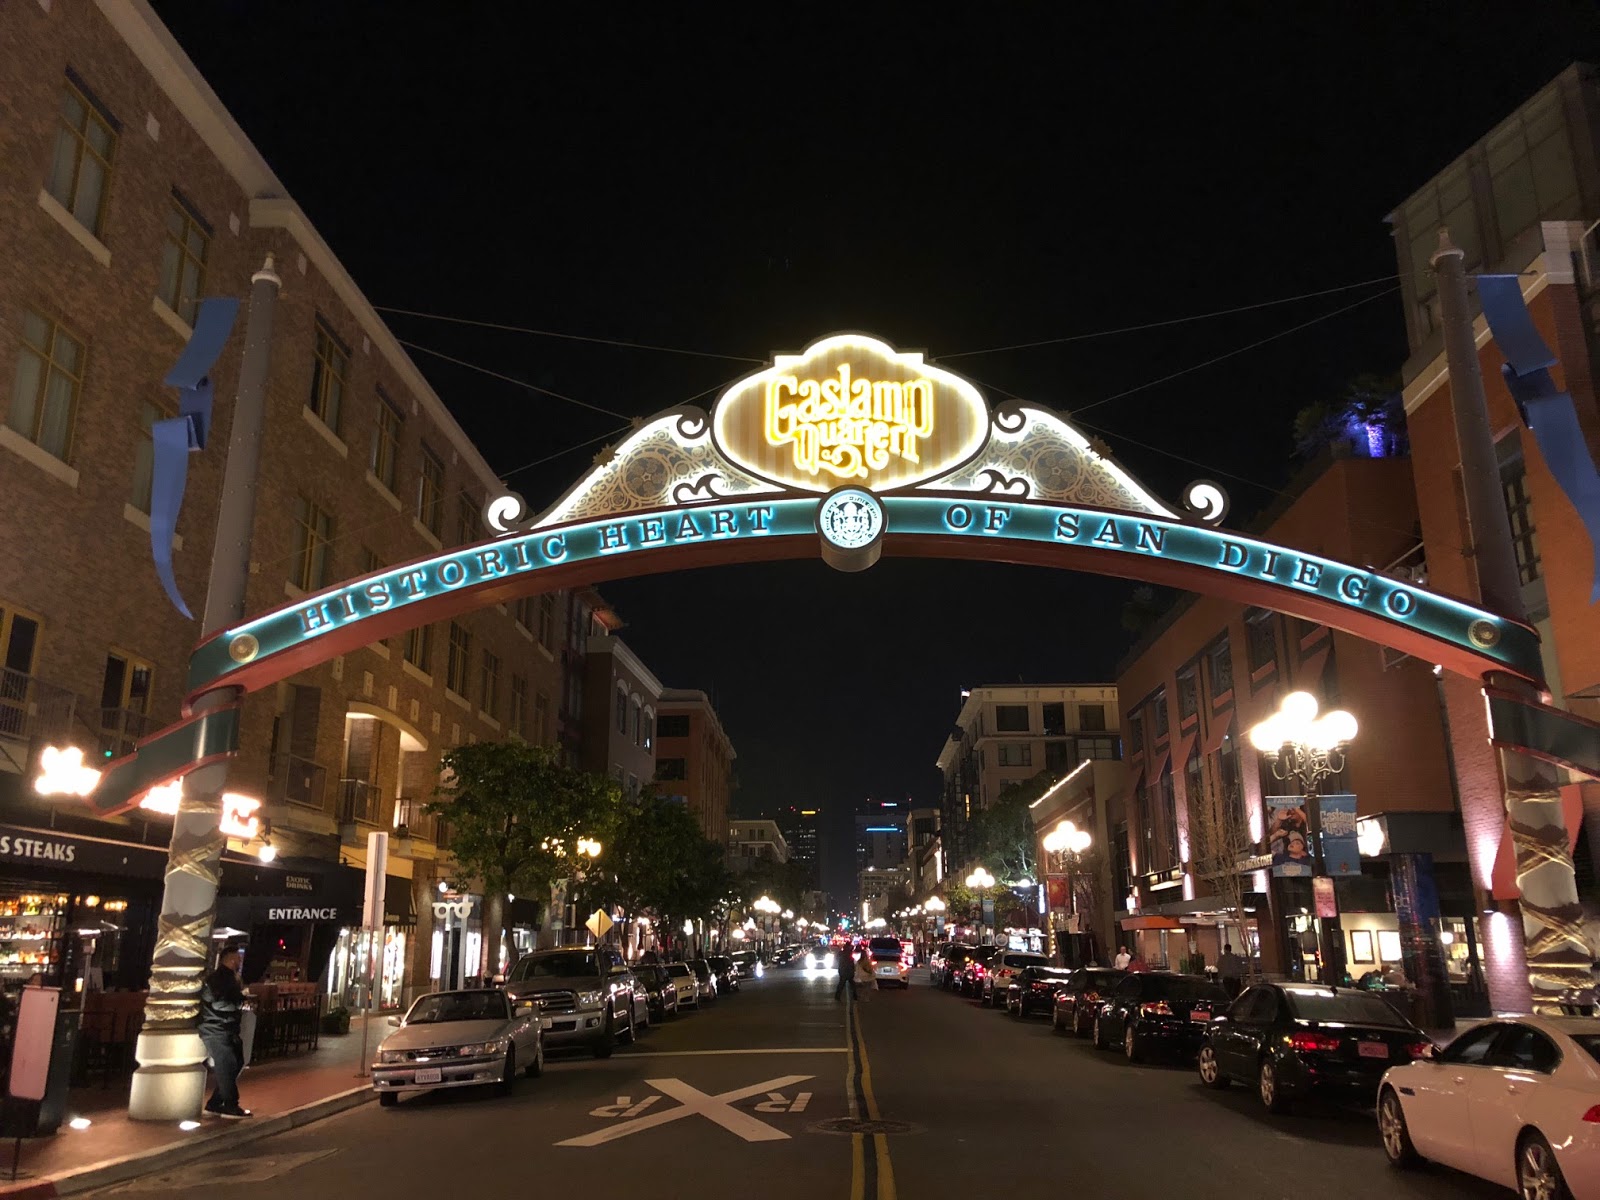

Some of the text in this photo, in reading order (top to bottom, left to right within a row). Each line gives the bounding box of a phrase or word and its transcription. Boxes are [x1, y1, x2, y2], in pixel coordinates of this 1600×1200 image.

[765, 363, 935, 460] Gaslamp
[793, 415, 920, 479] Quarter
[299, 532, 569, 637] HISTORIC
[599, 506, 774, 552] HEART
[944, 503, 1012, 535] OF
[1055, 512, 1169, 554] SAN
[1218, 540, 1417, 617] DIEGO
[13, 838, 75, 862] STEAKS
[286, 875, 311, 884] EXOTIC
[286, 882, 313, 891] DRINKS
[268, 908, 338, 920] ENTRANCE
